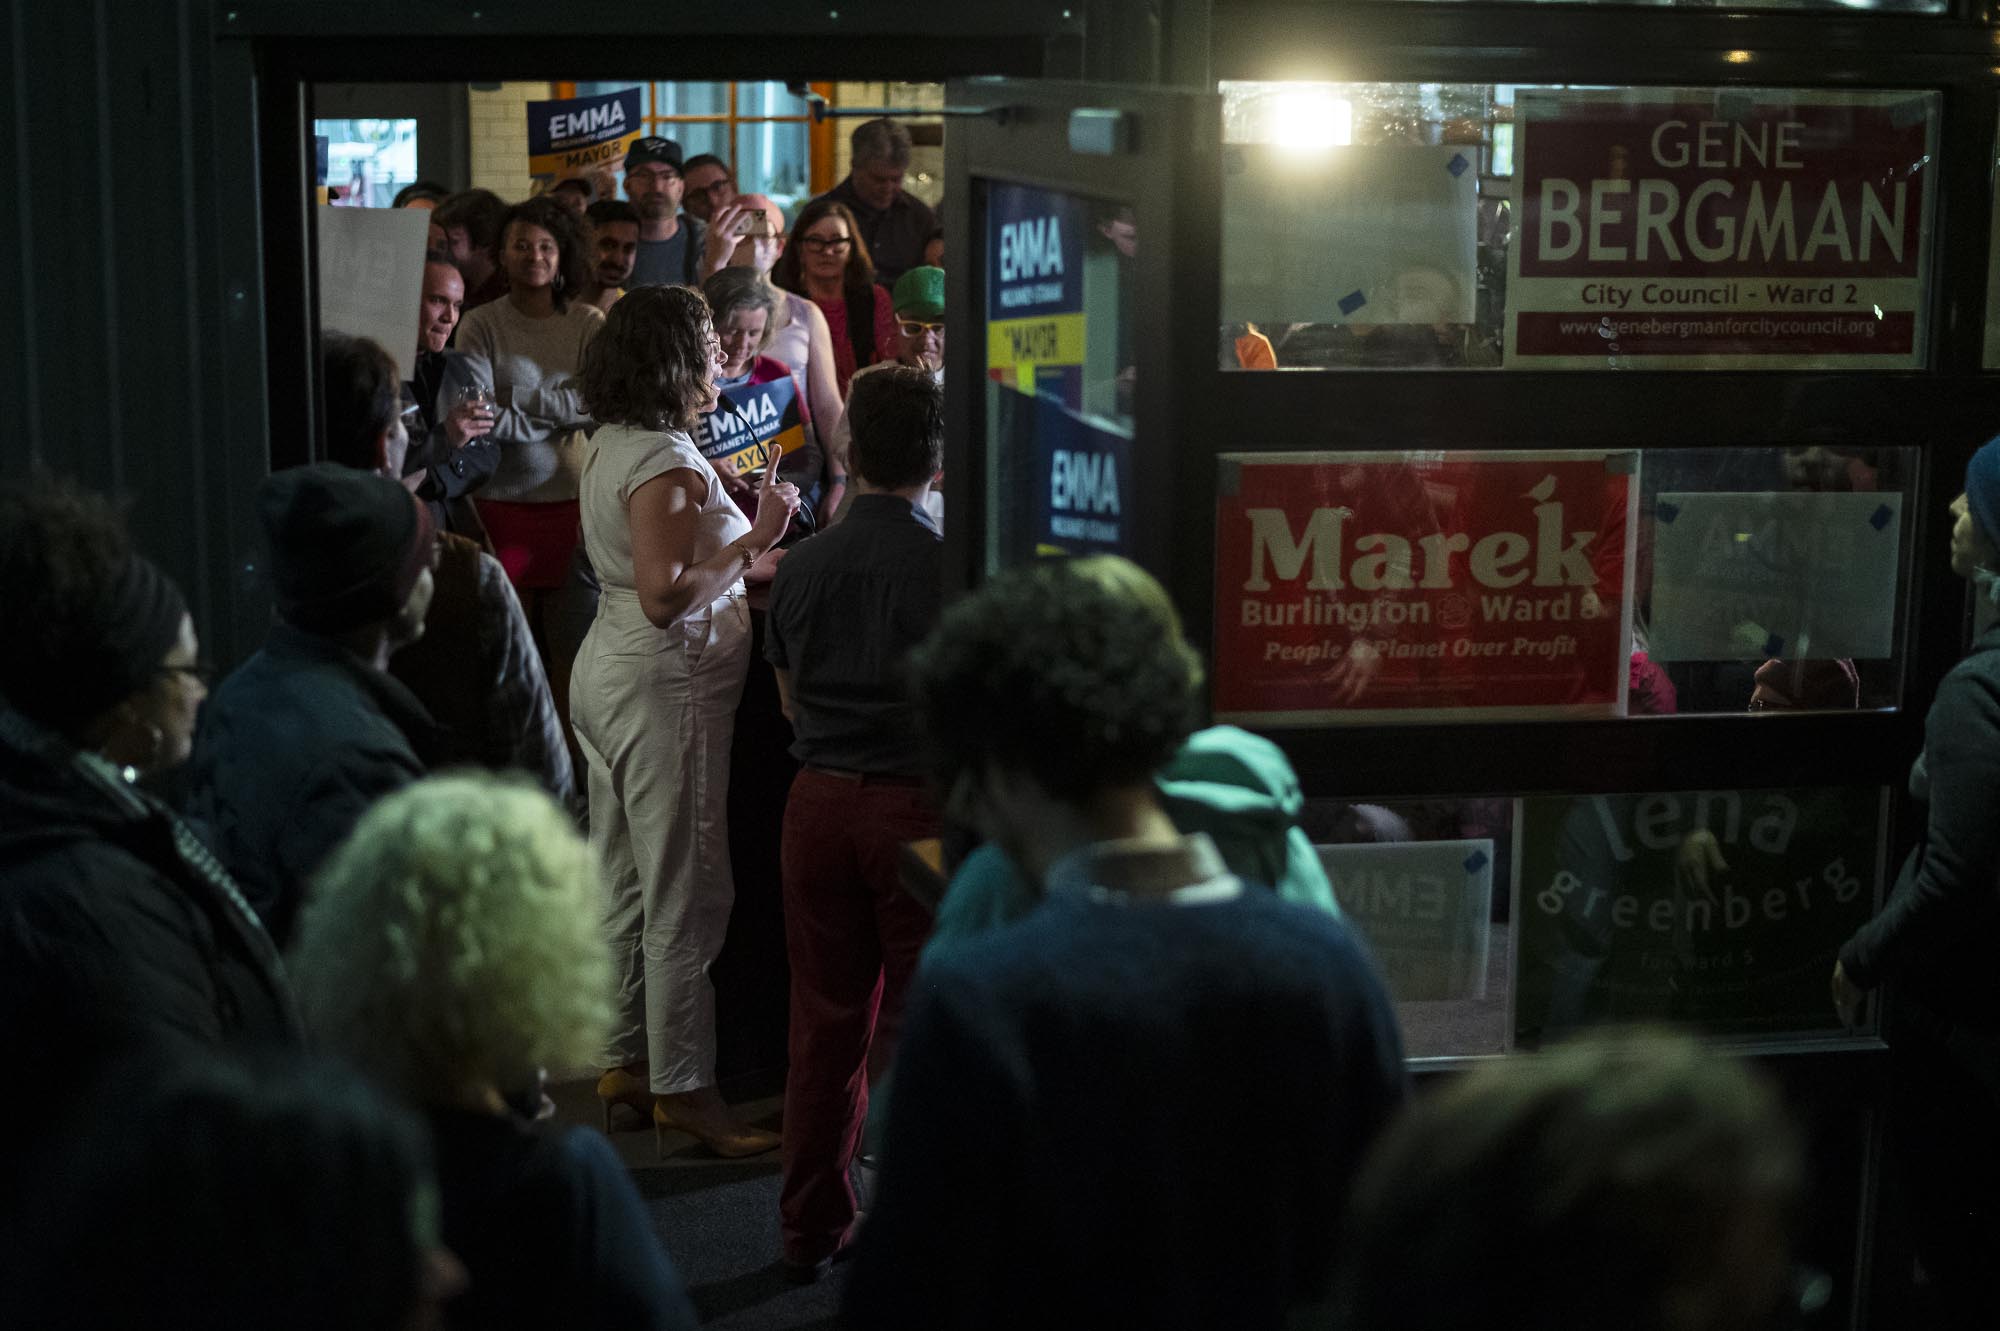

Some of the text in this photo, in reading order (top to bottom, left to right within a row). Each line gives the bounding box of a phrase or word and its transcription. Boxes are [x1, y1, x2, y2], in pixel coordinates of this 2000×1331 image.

[548, 99, 626, 139] EMMA
[566, 141, 620, 168] MAYOR
[1650, 120, 1806, 169] GENE
[1538, 178, 1907, 262] BERGMAN
[1001, 215, 1064, 281] EMMA
[1581, 284, 1632, 308] City
[1642, 284, 1738, 305] Council
[1766, 284, 1834, 305] Ward
[1845, 284, 1858, 304] 2
[1559, 317, 1875, 338] wwwgenebergmanforcitycouncil.org
[691, 392, 778, 448] EMMA
[1051, 450, 1120, 516] EMMA
[1243, 500, 1600, 591] Marek
[1241, 594, 1430, 632] Burlington
[1480, 592, 1572, 622] Ward
[1264, 639, 1343, 665] People
[1374, 639, 1448, 658] Planet
[1452, 638, 1507, 657] Over
[1510, 634, 1578, 661] Profit
[1537, 857, 1862, 933] greenberg
